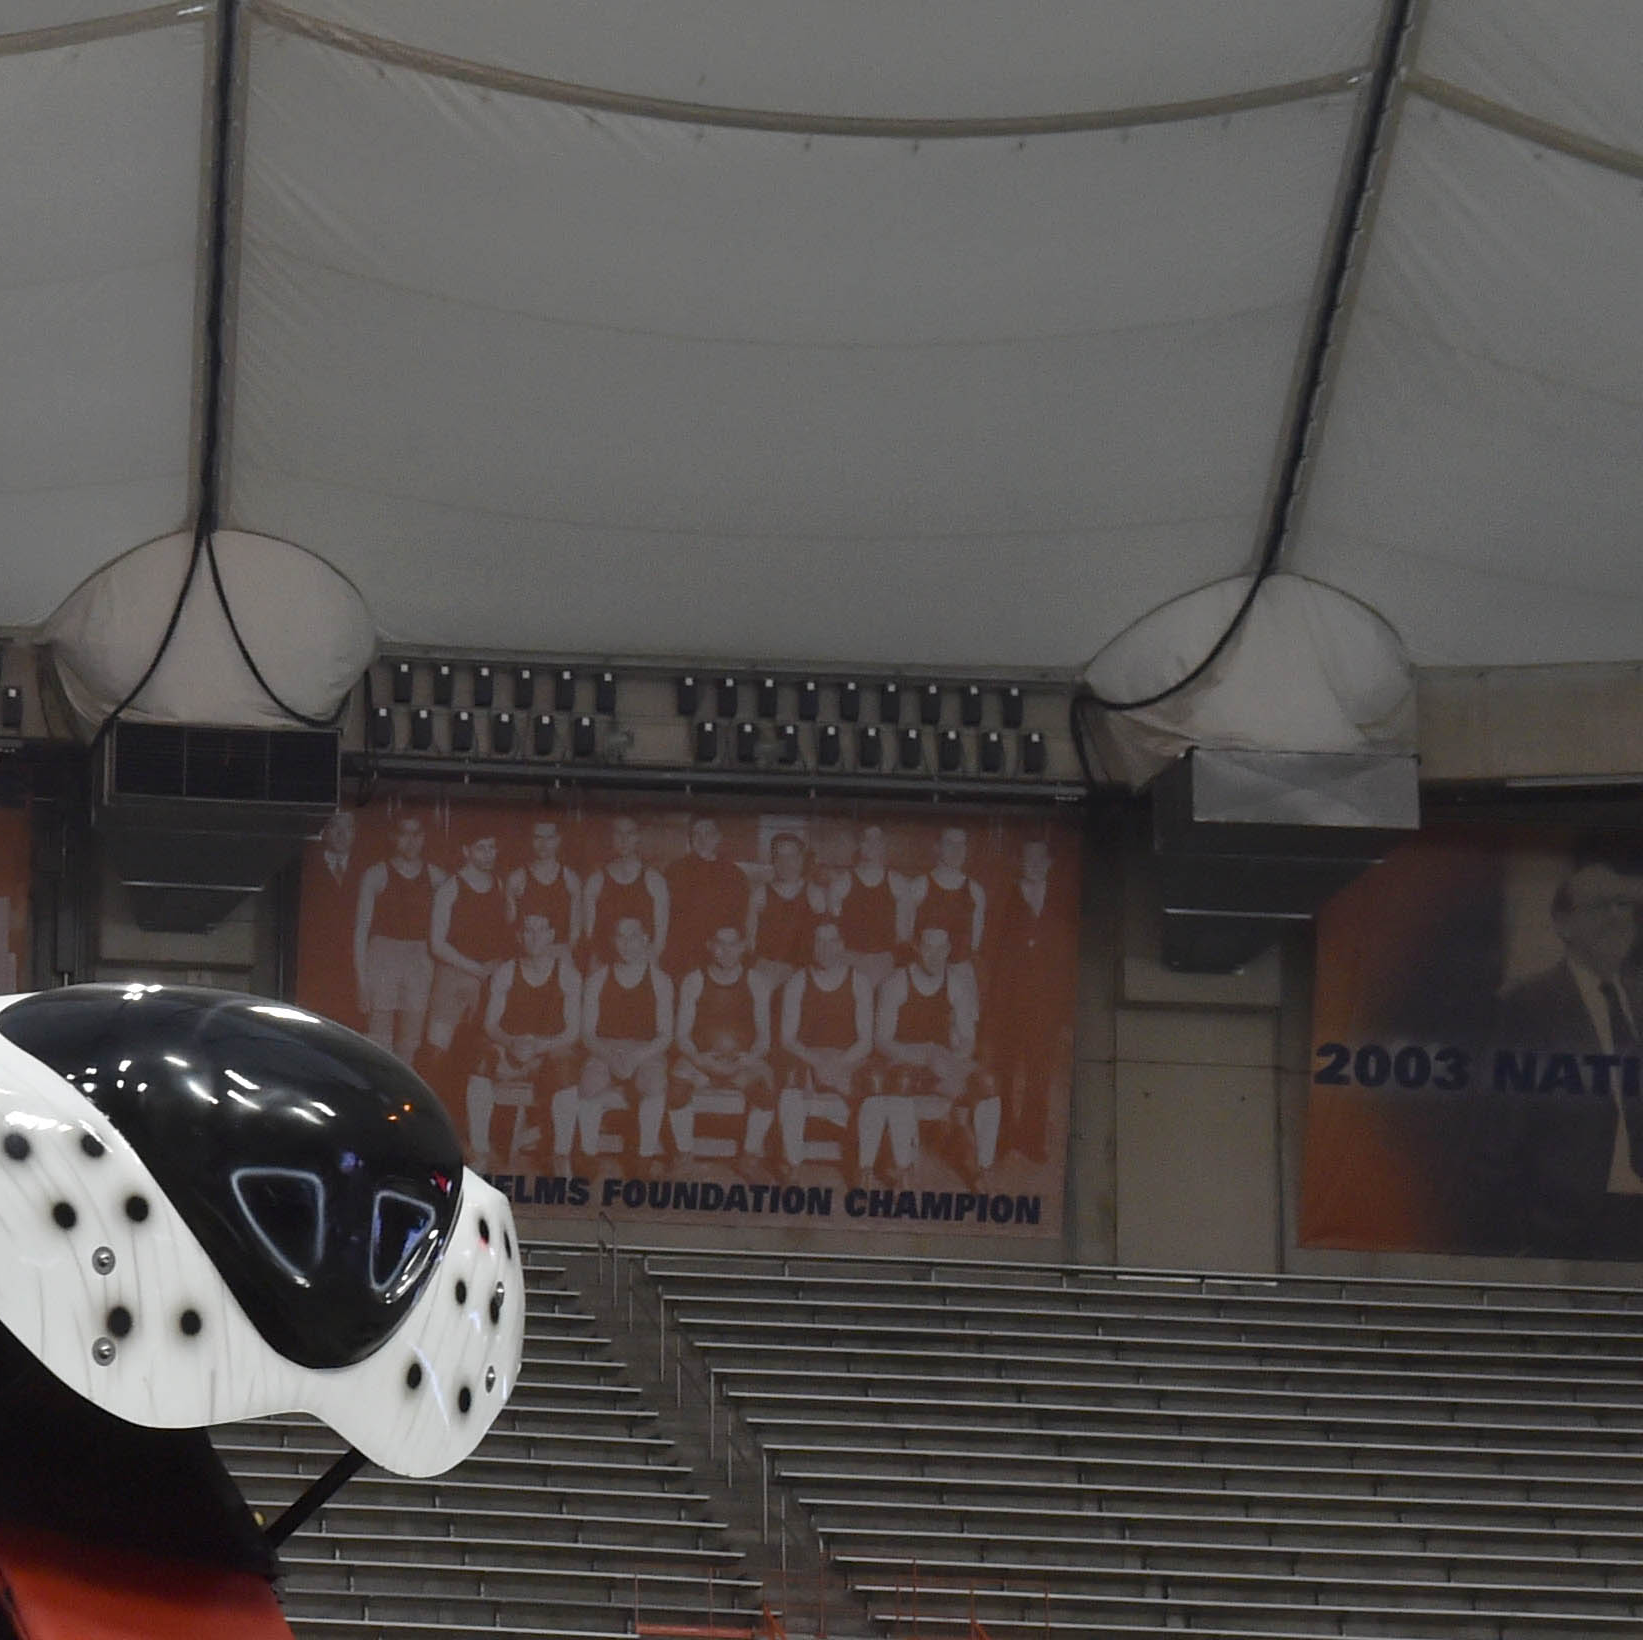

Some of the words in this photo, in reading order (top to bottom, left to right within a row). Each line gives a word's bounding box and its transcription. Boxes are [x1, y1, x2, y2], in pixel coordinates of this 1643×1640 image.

[1315, 1043, 1470, 1091] 2003
[485, 1173, 591, 1206] ELMS
[603, 1175, 835, 1217] FOUNDATION
[845, 1188, 1042, 1226] CHAMPION
